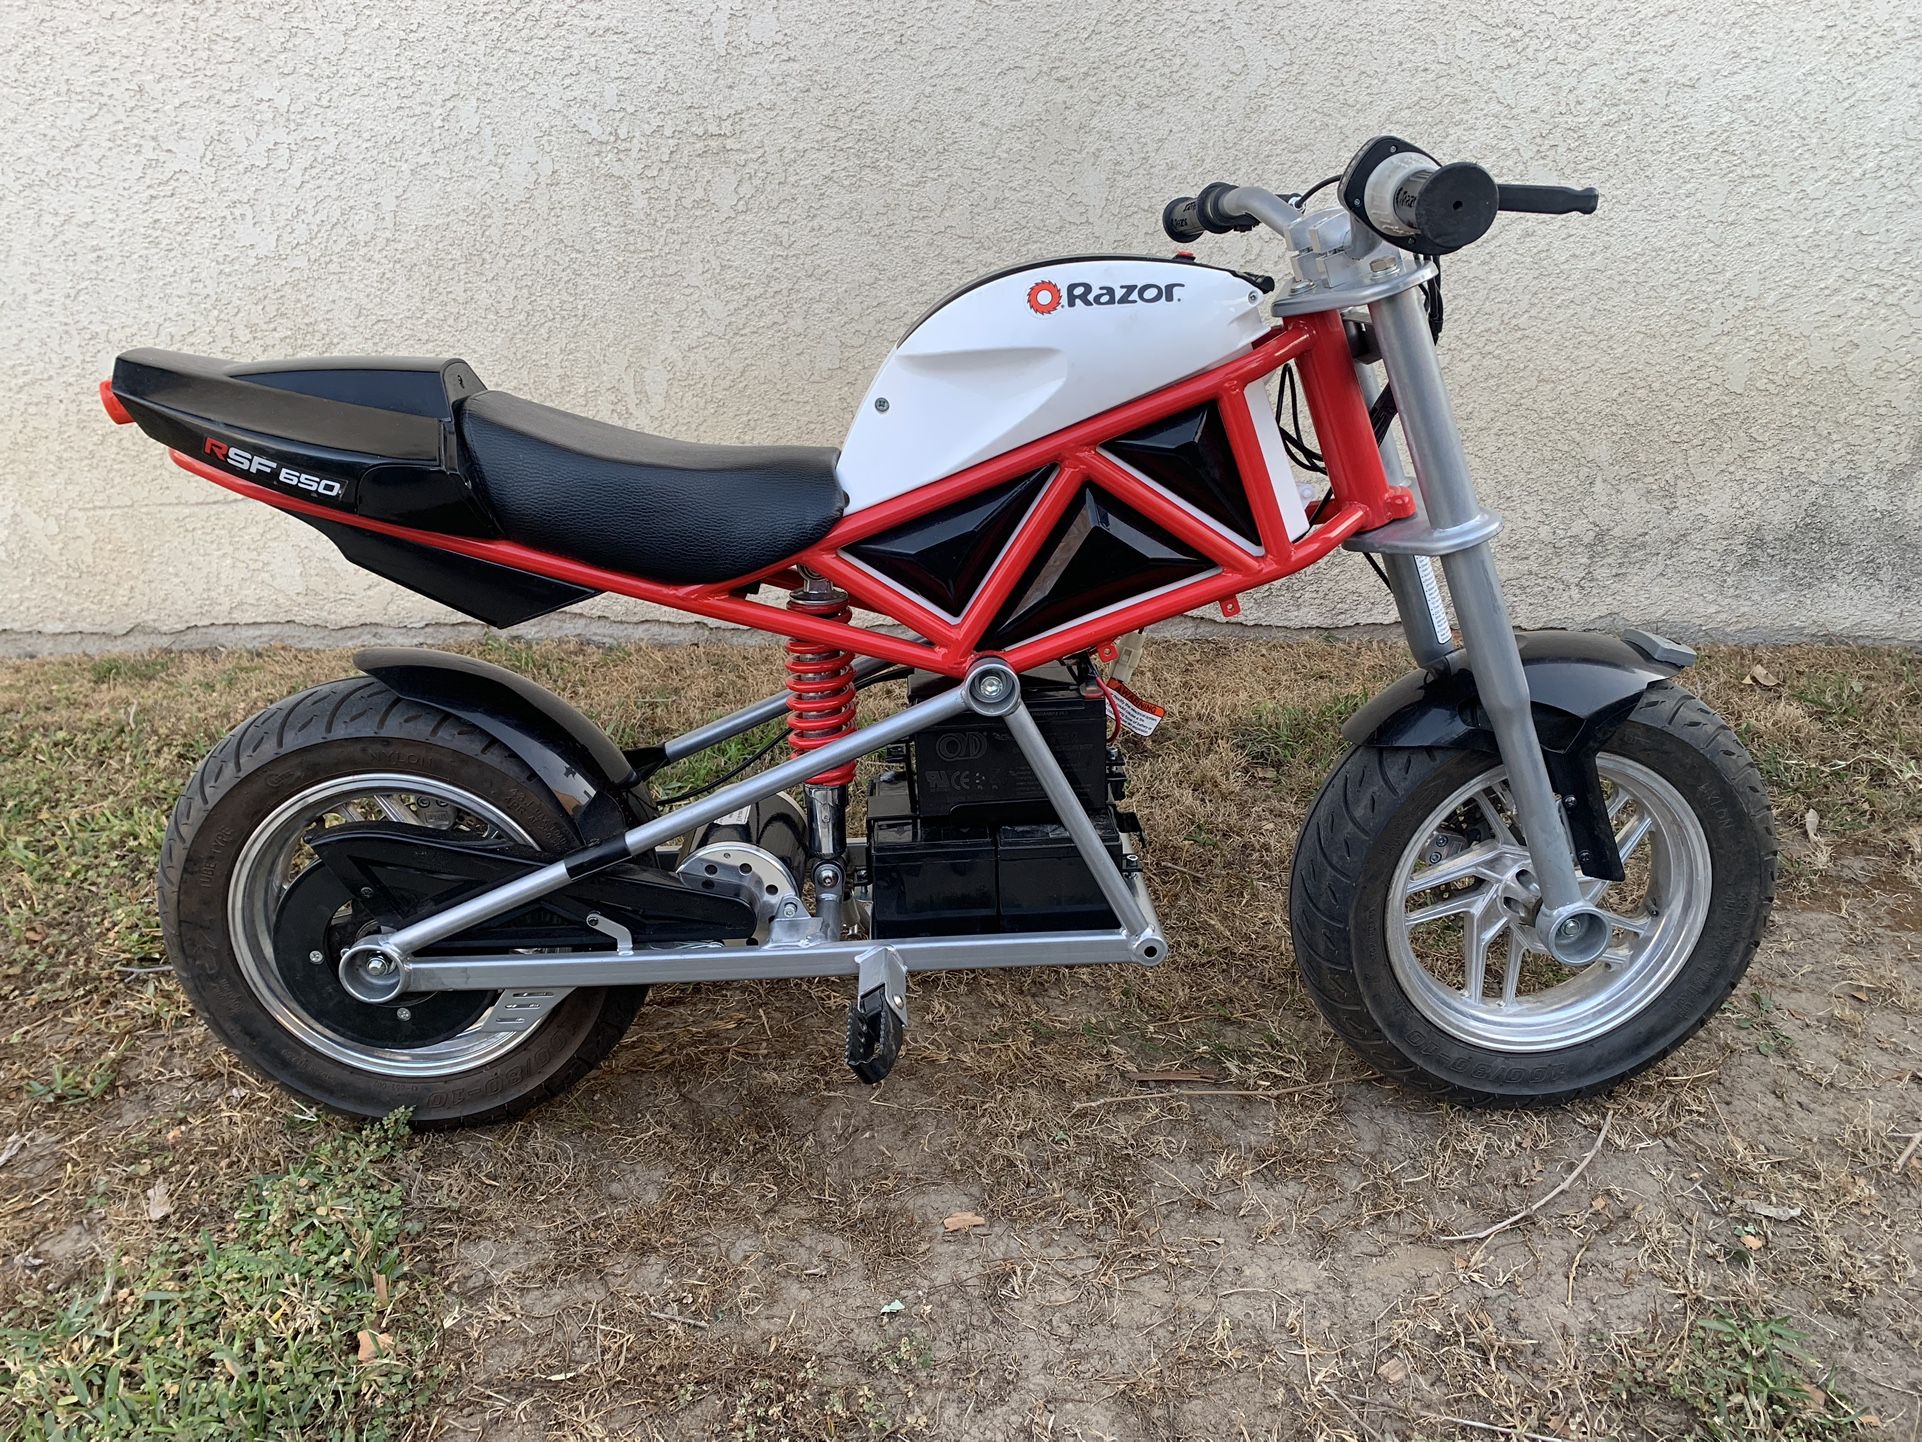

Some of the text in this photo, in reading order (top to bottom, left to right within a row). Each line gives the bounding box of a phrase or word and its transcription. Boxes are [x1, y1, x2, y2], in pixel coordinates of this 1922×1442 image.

[1066, 282, 1185, 308] Razor
[203, 436, 341, 497] RSF 650
